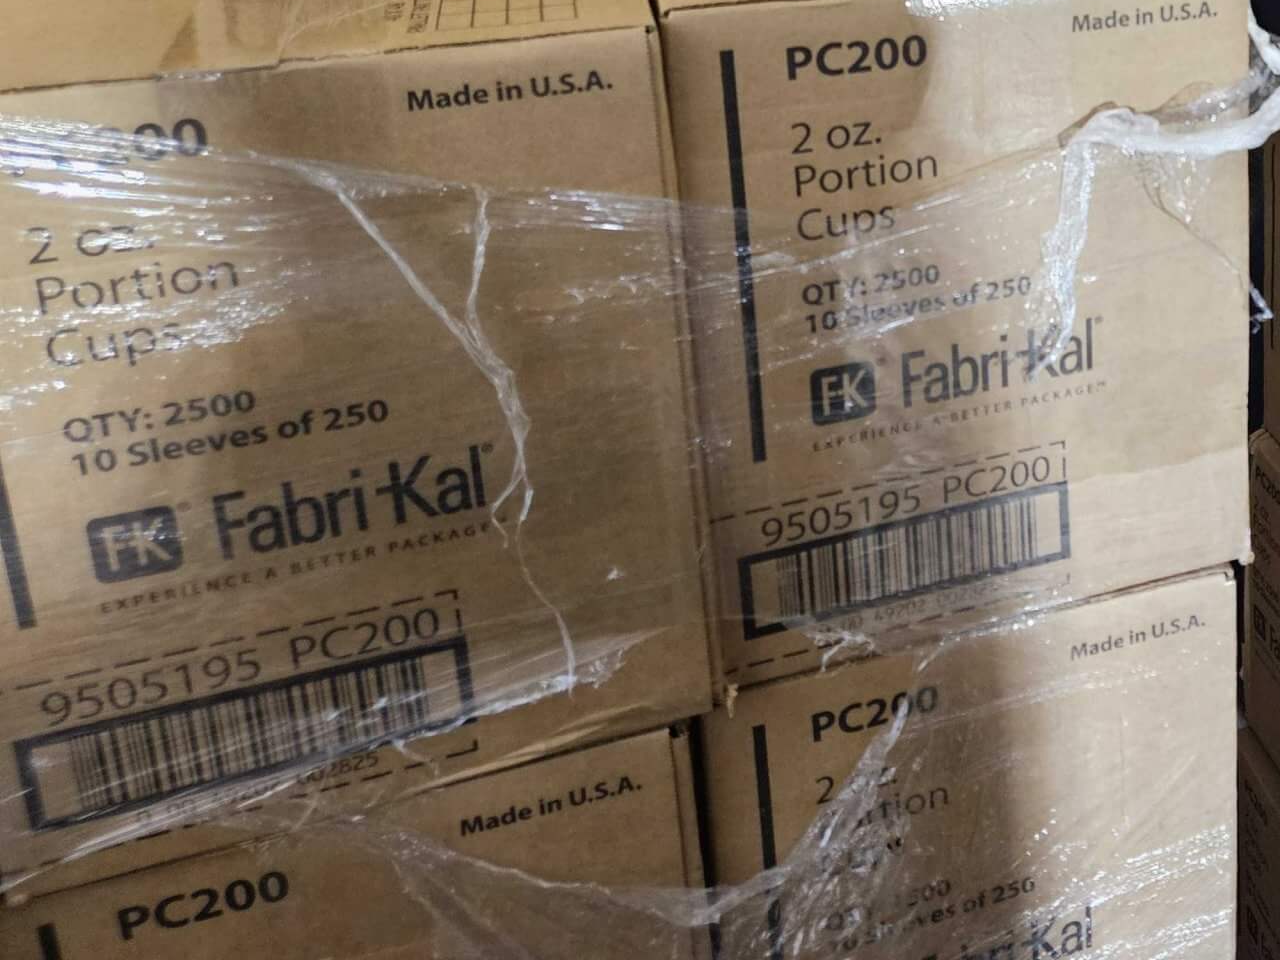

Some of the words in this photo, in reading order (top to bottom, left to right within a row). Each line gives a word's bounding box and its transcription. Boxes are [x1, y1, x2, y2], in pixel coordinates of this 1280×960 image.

[1071, 13, 1131, 34] Made
[1136, 8, 1154, 26] in
[1160, 2, 1218, 23] U.S.A.
[786, 35, 928, 80] PC200
[407, 79, 488, 113] Made
[495, 79, 523, 102] in
[530, 66, 614, 99] U.S.A.
[790, 122, 814, 156] 2
[826, 120, 882, 148] oz.
[793, 154, 938, 198] Portion
[27, 227, 58, 264] 2
[798, 205, 897, 245] Cups
[34, 257, 240, 314] Portion
[802, 277, 869, 307] QTY:
[873, 264, 940, 295] 2500
[805, 313, 837, 334] 10
[847, 292, 947, 327] Sleeves
[952, 282, 982, 307] of
[988, 275, 1032, 302] 250
[46, 321, 181, 368] Cups
[816, 366, 872, 420] FK
[902, 317, 1094, 409] Fabri-Kal
[63, 406, 154, 442] QTY:
[165, 389, 257, 427] 2500
[71, 448, 117, 476] 10
[128, 425, 268, 468] Sleeves
[277, 412, 316, 439] of
[323, 399, 389, 432] 250
[95, 512, 179, 578] FK
[213, 444, 488, 560] Fabri-Kal
[761, 483, 921, 548] 9505195
[943, 454, 1050, 505] PC200
[100, 572, 252, 615] EXPERIENCE
[265, 565, 277, 580] A
[291, 547, 377, 574] BETTER
[1070, 637, 1124, 662] Made
[1128, 630, 1147, 646] in
[1152, 616, 1207, 640] U.S.A.
[41, 648, 261, 727] 9505195
[288, 608, 440, 670] PC200
[459, 807, 533, 838] Made
[540, 796, 562, 818] in
[570, 776, 643, 807] U.S.A.
[816, 776, 834, 805] 2
[117, 871, 289, 941] PC200
[992, 877, 1035, 904] 250
